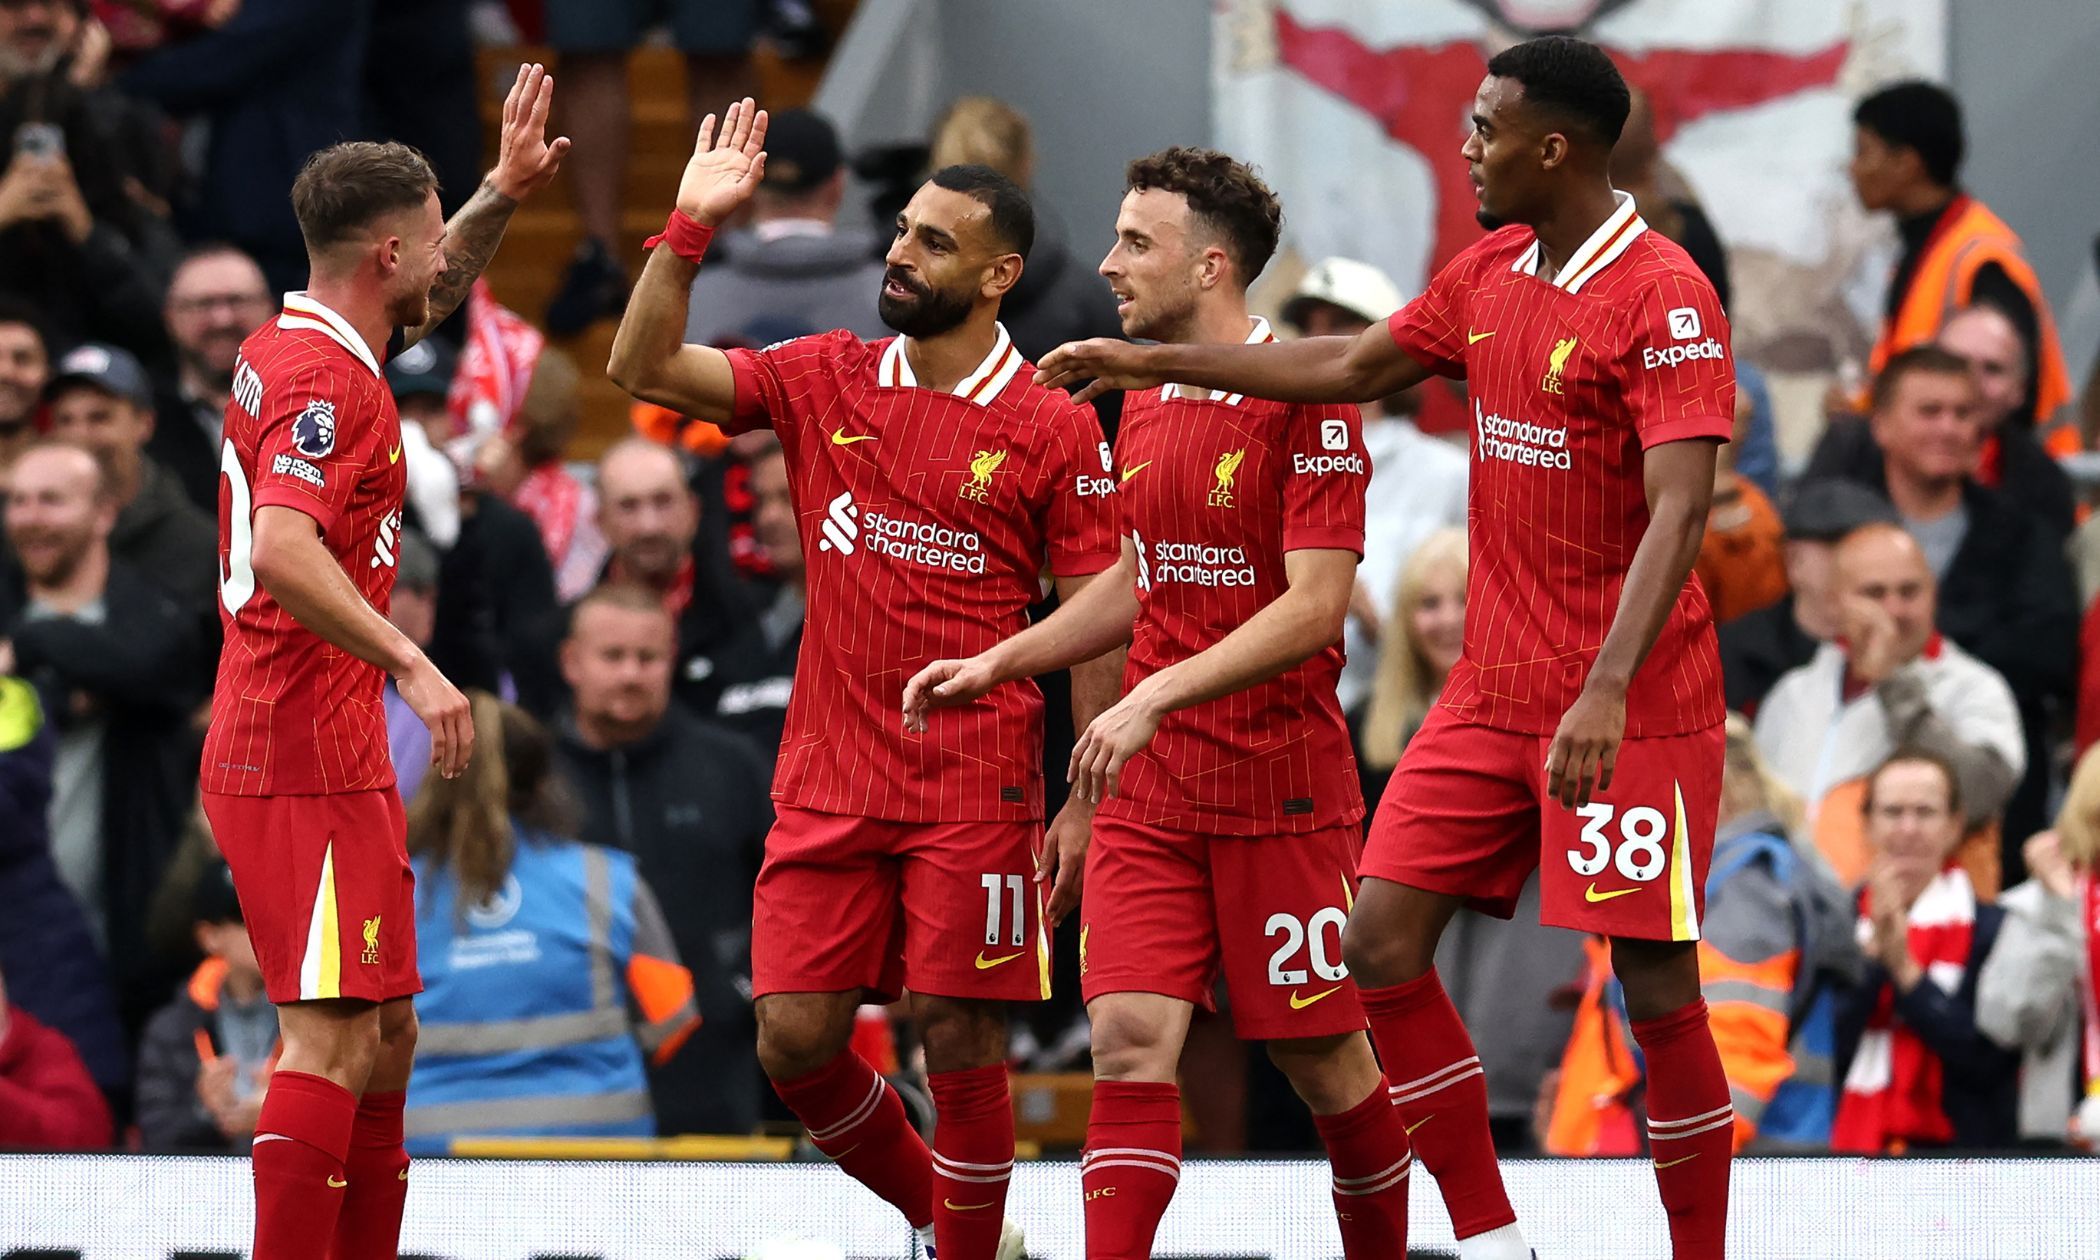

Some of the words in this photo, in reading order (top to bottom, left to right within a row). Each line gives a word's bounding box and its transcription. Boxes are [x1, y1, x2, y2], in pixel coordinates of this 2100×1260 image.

[1643, 337, 1724, 369] Expedia
[1485, 412, 1568, 448] standard
[275, 454, 293, 467] No
[293, 458, 321, 479] room
[1486, 436, 1572, 469] chartered
[863, 511, 979, 551] standard
[865, 530, 985, 574] chartered
[1156, 561, 1255, 587] chartered
[1567, 802, 1667, 882] 38
[981, 873, 1024, 947] 11
[1264, 906, 1350, 985] 20
[1085, 1186, 1117, 1201] LFC
